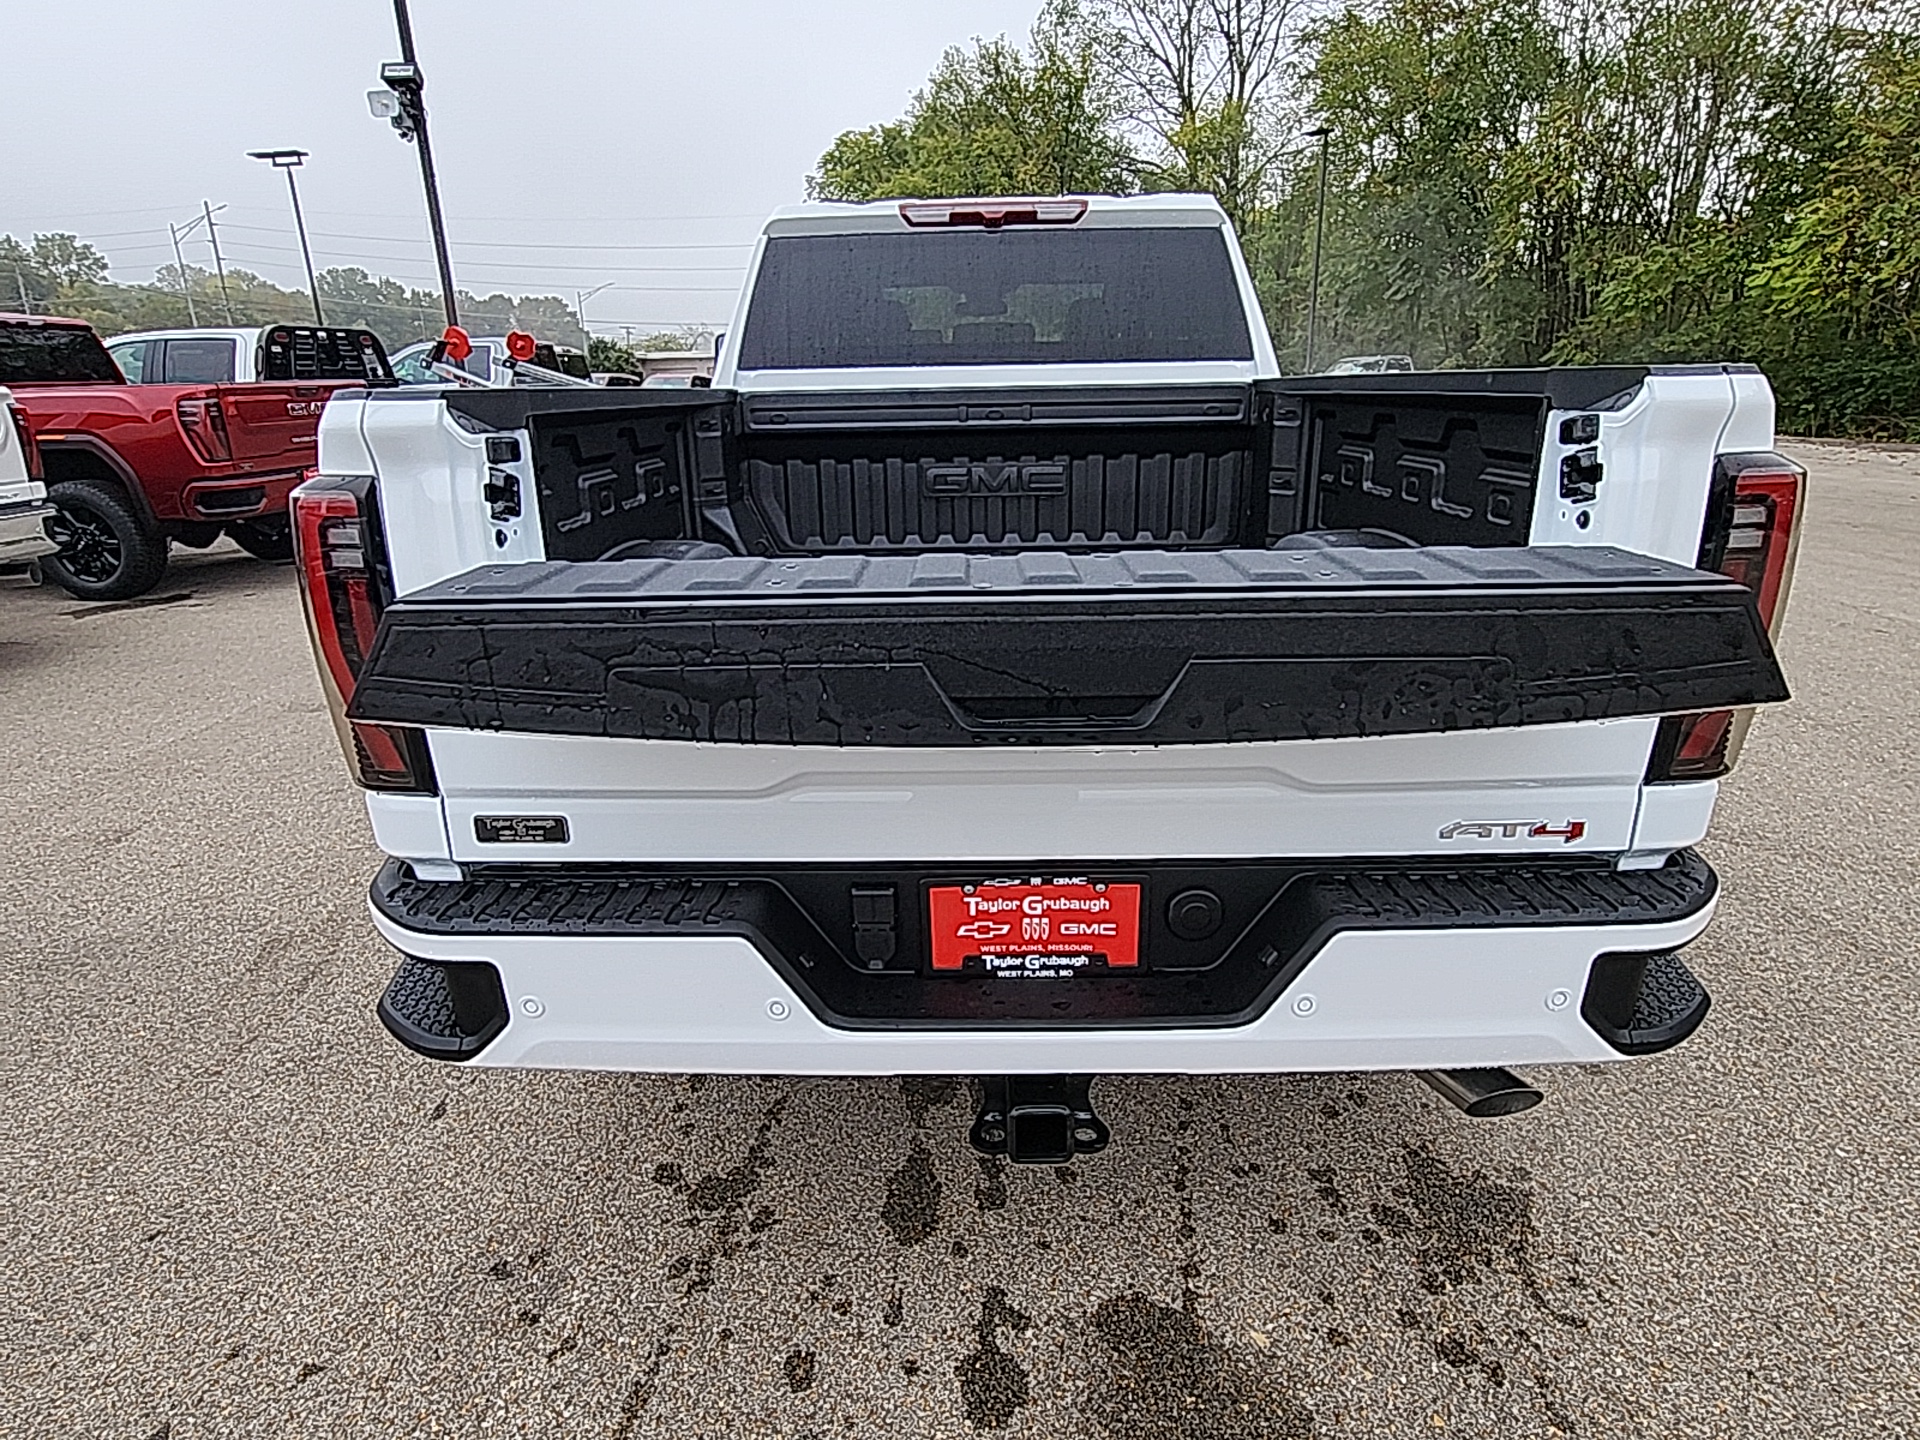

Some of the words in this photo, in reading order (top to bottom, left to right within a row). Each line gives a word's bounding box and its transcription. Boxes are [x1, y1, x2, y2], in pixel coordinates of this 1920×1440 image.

[287, 401, 326, 416] GM
[925, 466, 1065, 493] GMC
[1439, 818, 1586, 844] AT4
[1053, 877, 1088, 885] GMC
[963, 897, 1020, 916] Taylor
[1022, 896, 1110, 915] Grubaugh
[1060, 923, 1117, 935] GMC
[980, 945, 1006, 953] WEST
[1009, 944, 1045, 953] PLAINS,
[1048, 944, 1093, 952] MISSOURI
[981, 954, 1023, 970] Taylor
[1025, 954, 1089, 970] Grubaugh
[997, 970, 1021, 978] WEST
[1059, 969, 1074, 977] MO
